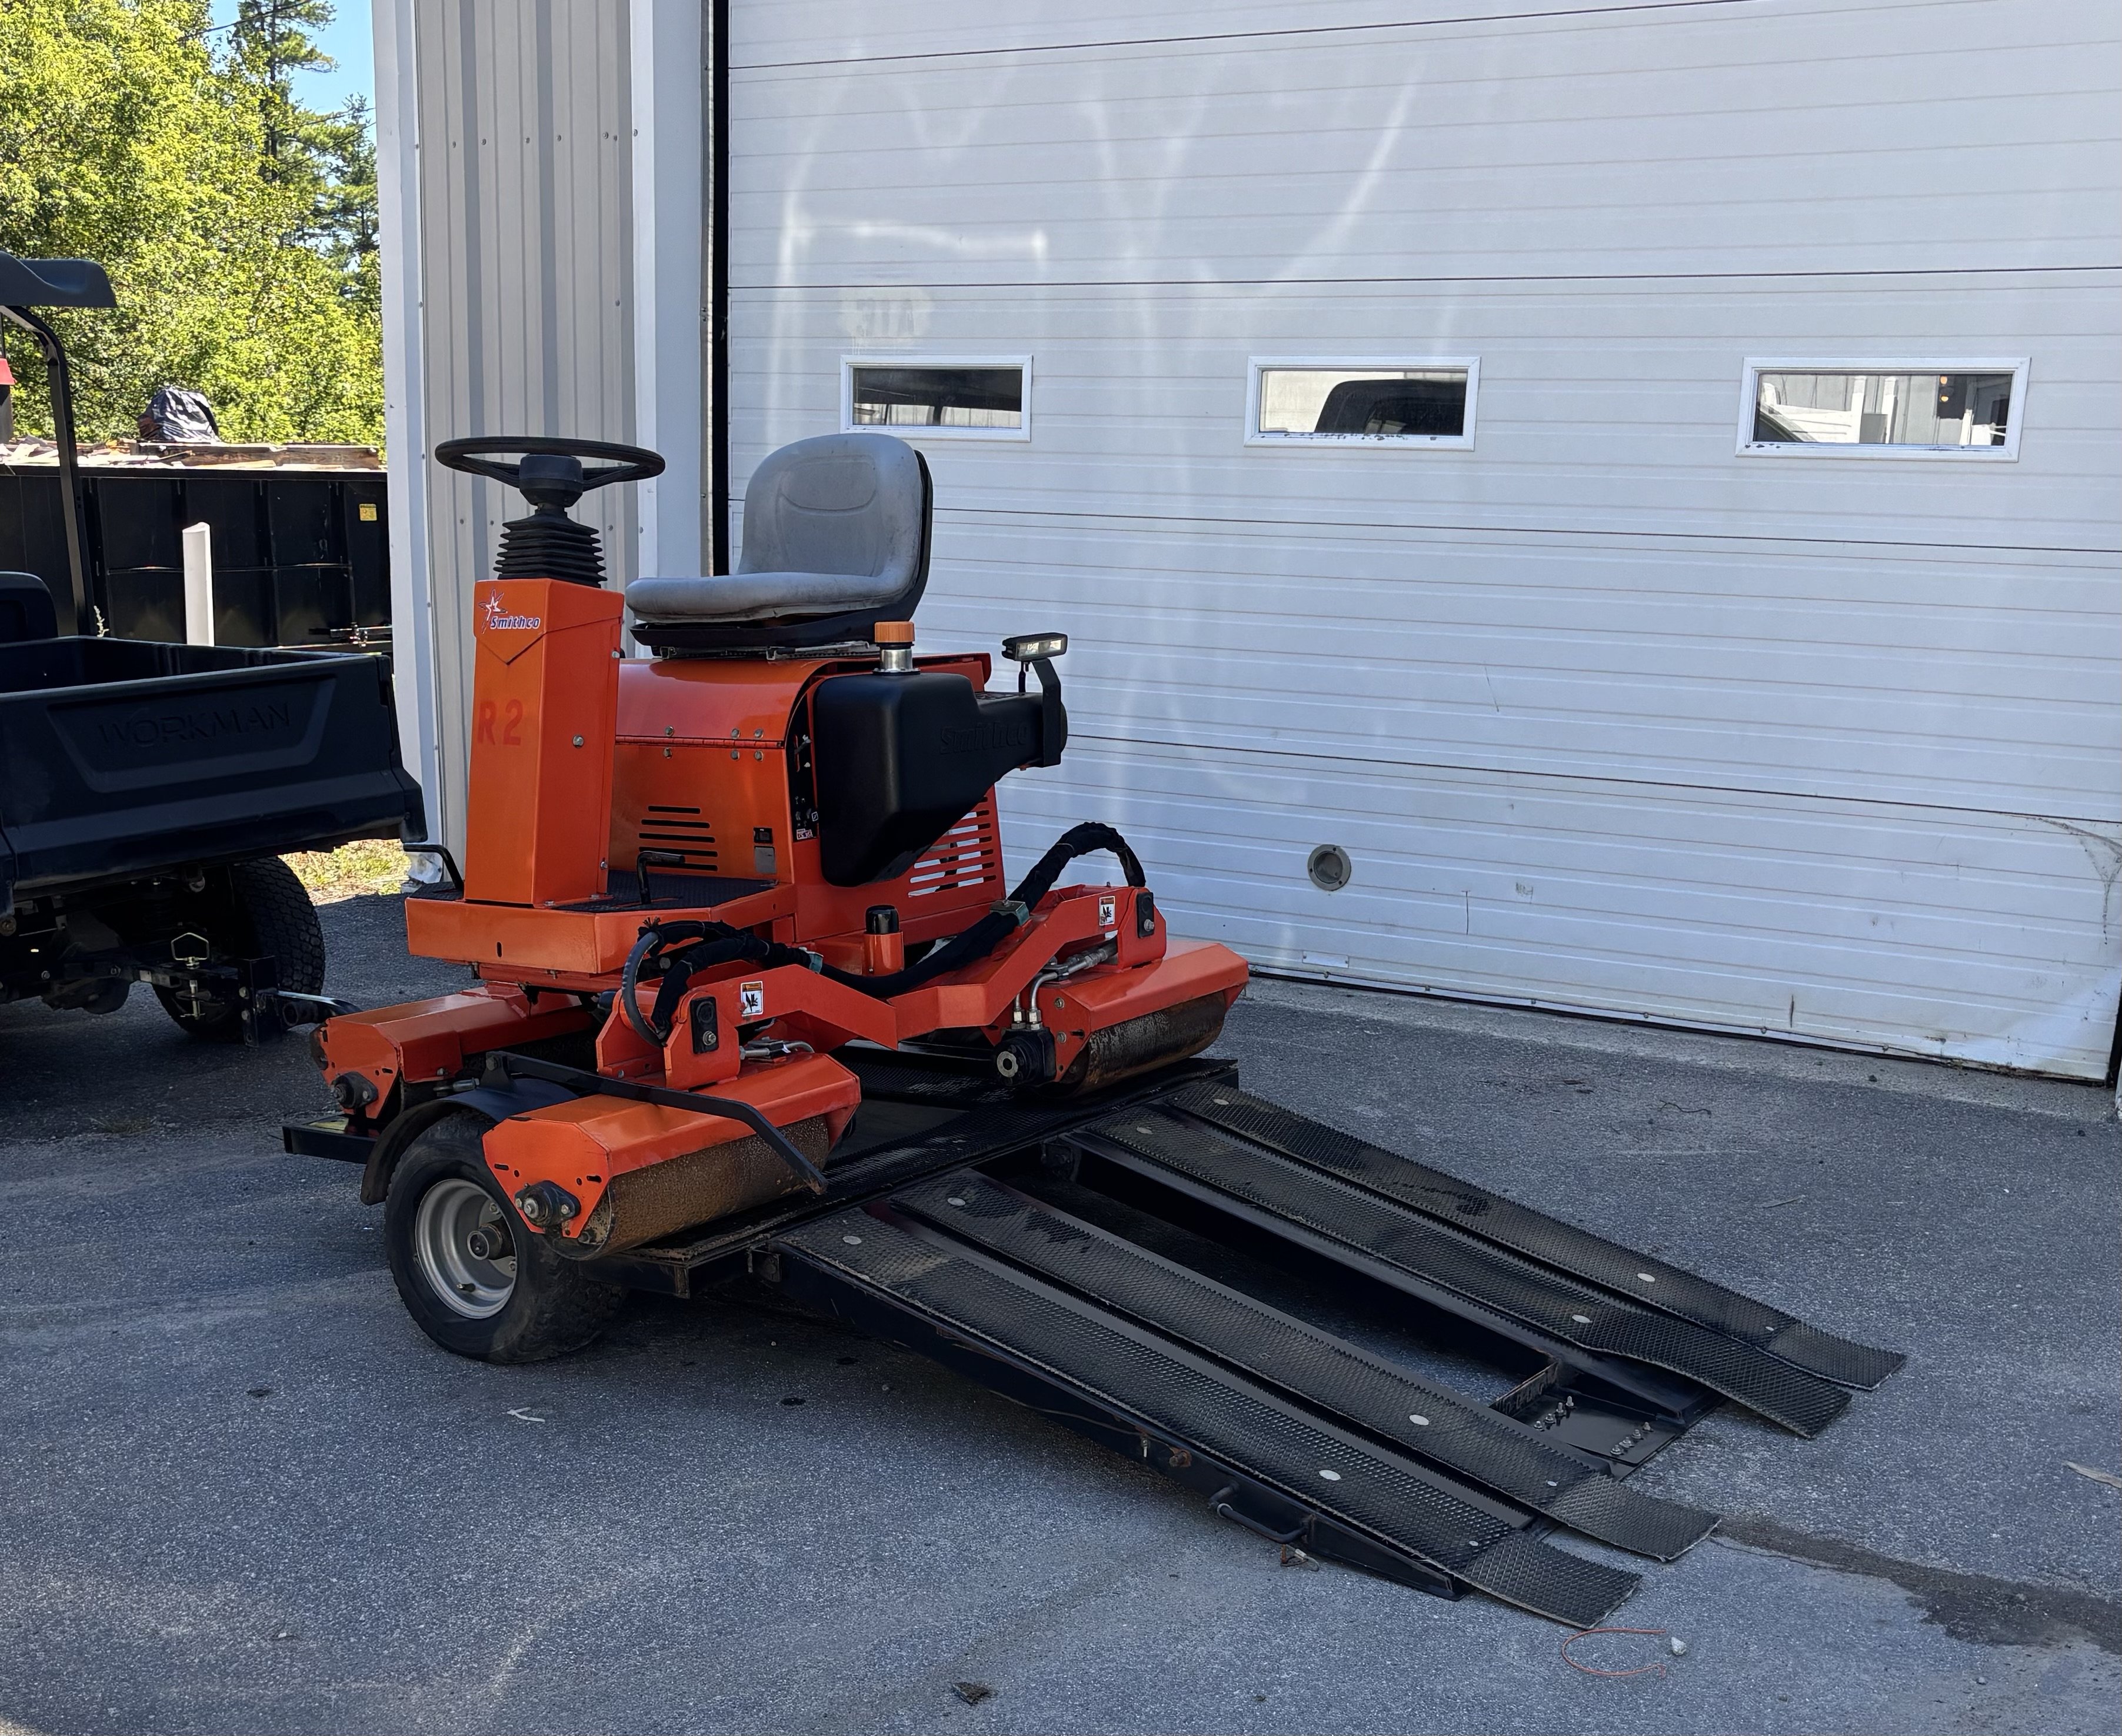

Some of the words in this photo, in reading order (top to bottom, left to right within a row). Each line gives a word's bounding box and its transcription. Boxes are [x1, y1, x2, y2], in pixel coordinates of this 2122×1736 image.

[490, 616, 541, 629] Smithco
[98, 702, 291, 747] WORKMAN
[478, 699, 524, 746] R2
[940, 721, 1027, 755] Smithco
